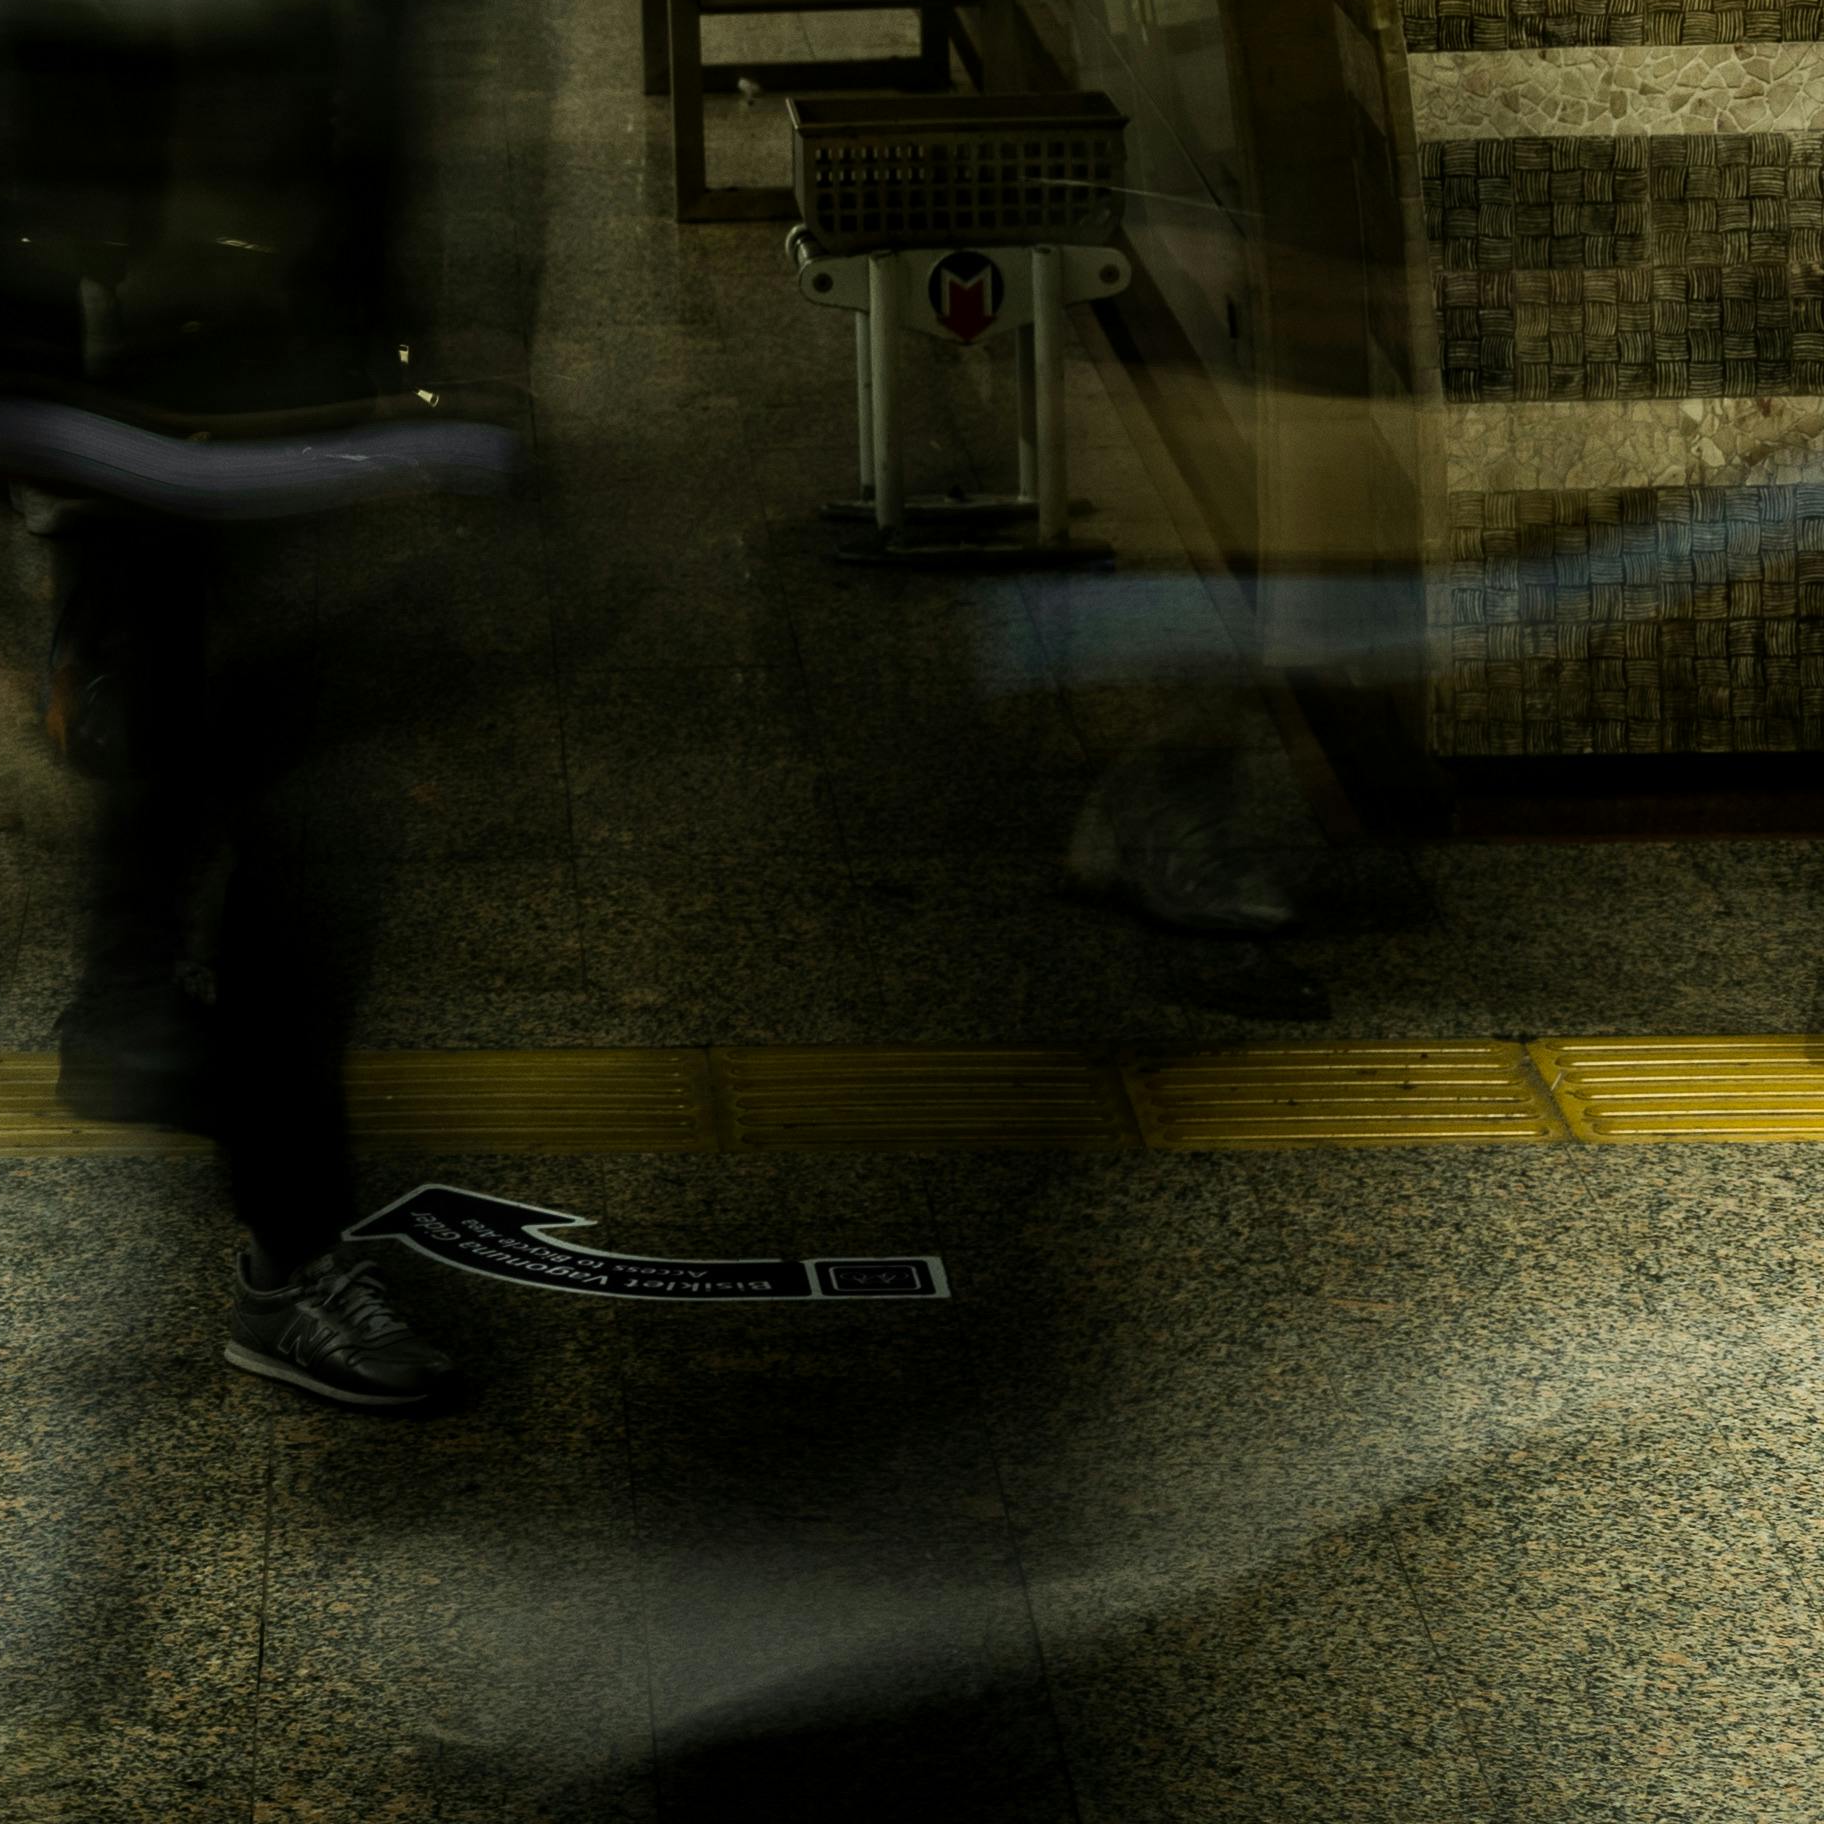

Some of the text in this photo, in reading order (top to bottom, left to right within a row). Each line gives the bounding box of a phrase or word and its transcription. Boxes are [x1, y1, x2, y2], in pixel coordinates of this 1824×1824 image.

[410, 1211, 773, 1292] Bisiklet Vagonuna Gider
[461, 1218, 708, 1278] Access to Bicycle Area
